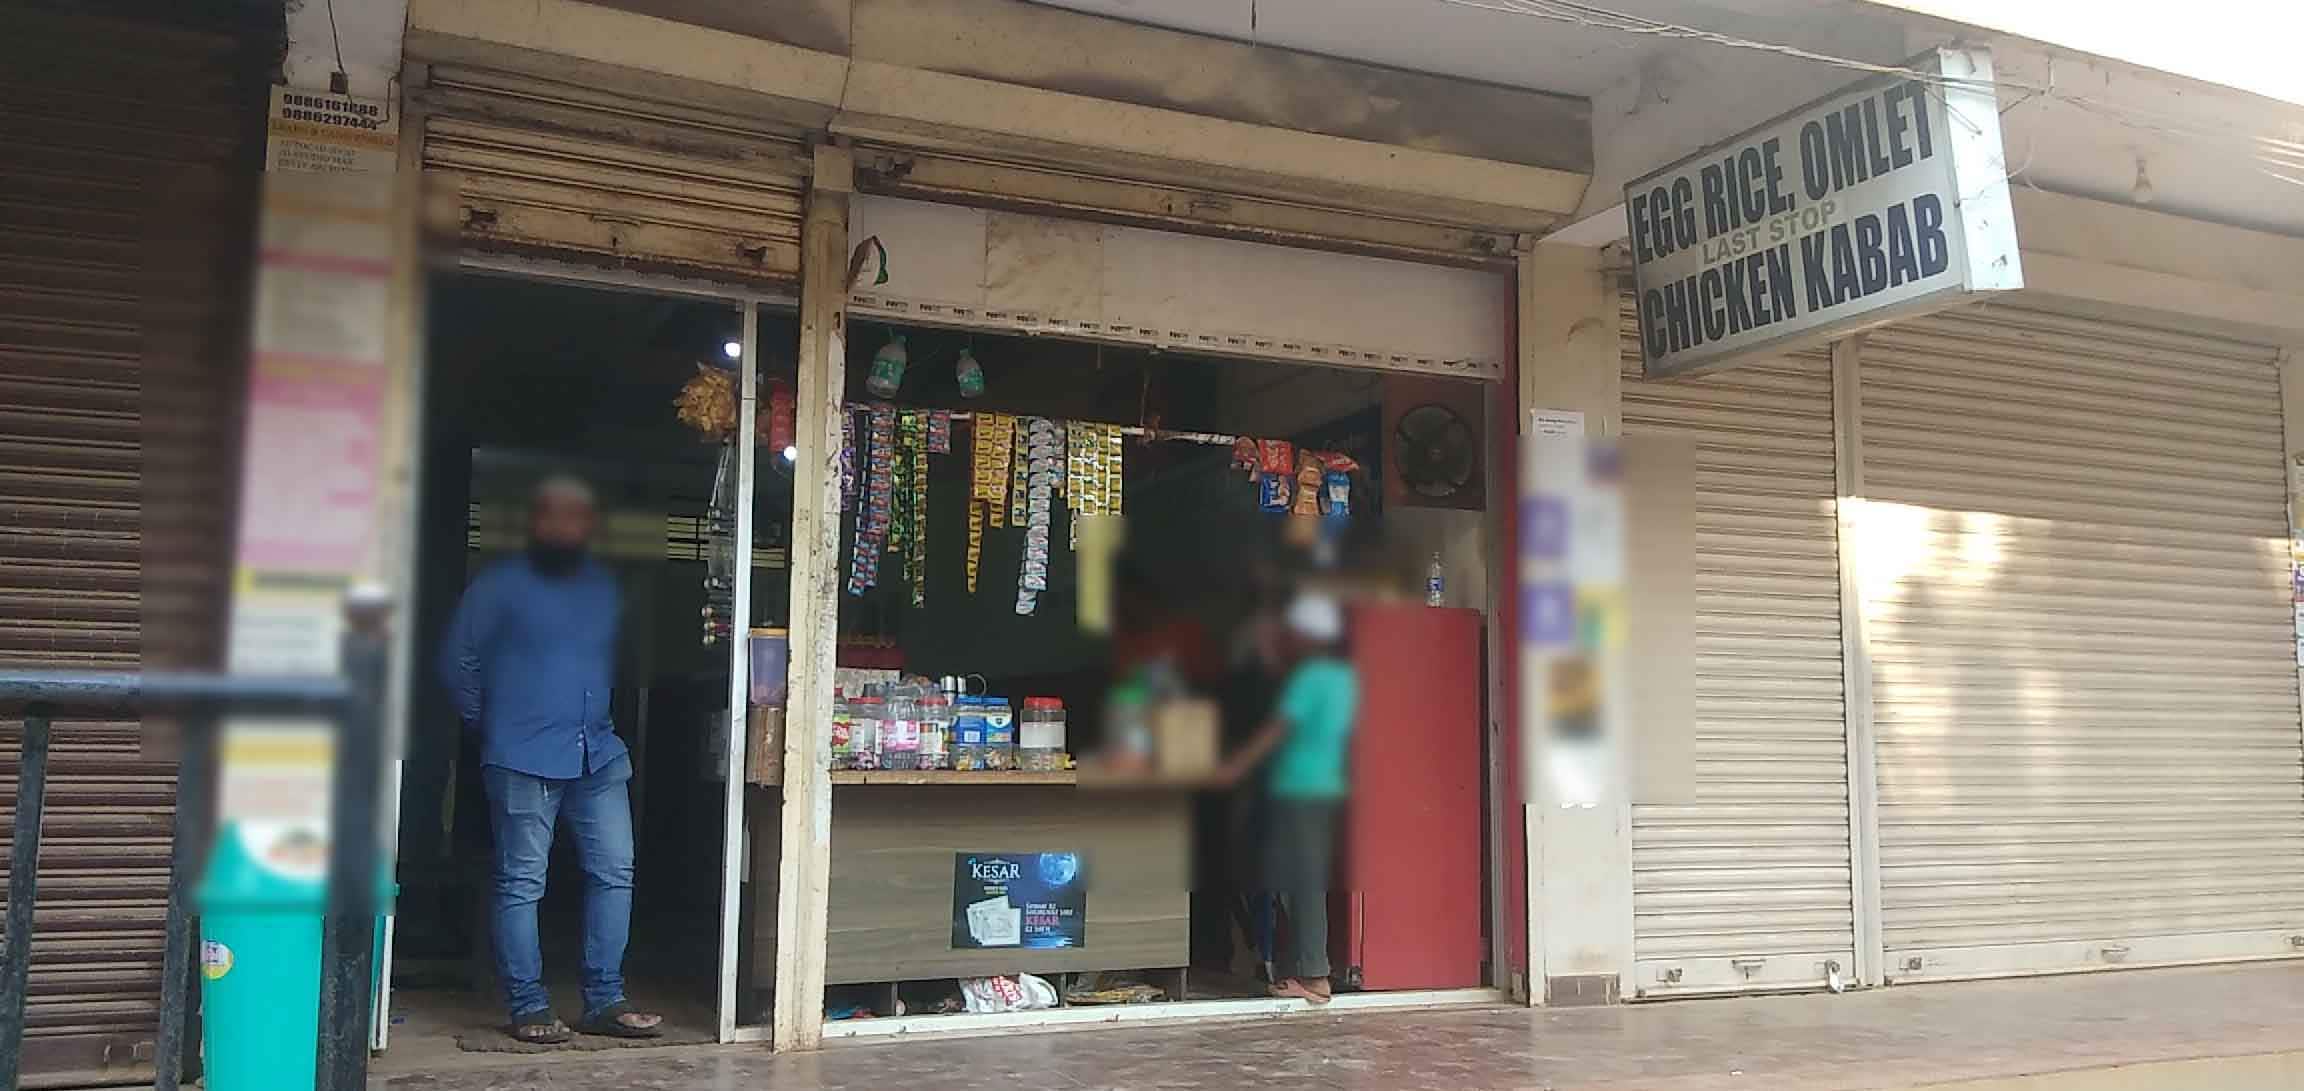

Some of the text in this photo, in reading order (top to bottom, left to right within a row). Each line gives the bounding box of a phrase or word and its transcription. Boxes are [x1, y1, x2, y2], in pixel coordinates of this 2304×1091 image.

[1633, 80, 1934, 263] EGG RICE, OMLET
[1643, 194, 1949, 359] CHICKEN KABAB
[1703, 201, 1836, 264] LAST STOP
[972, 863, 1021, 879] KESAR
